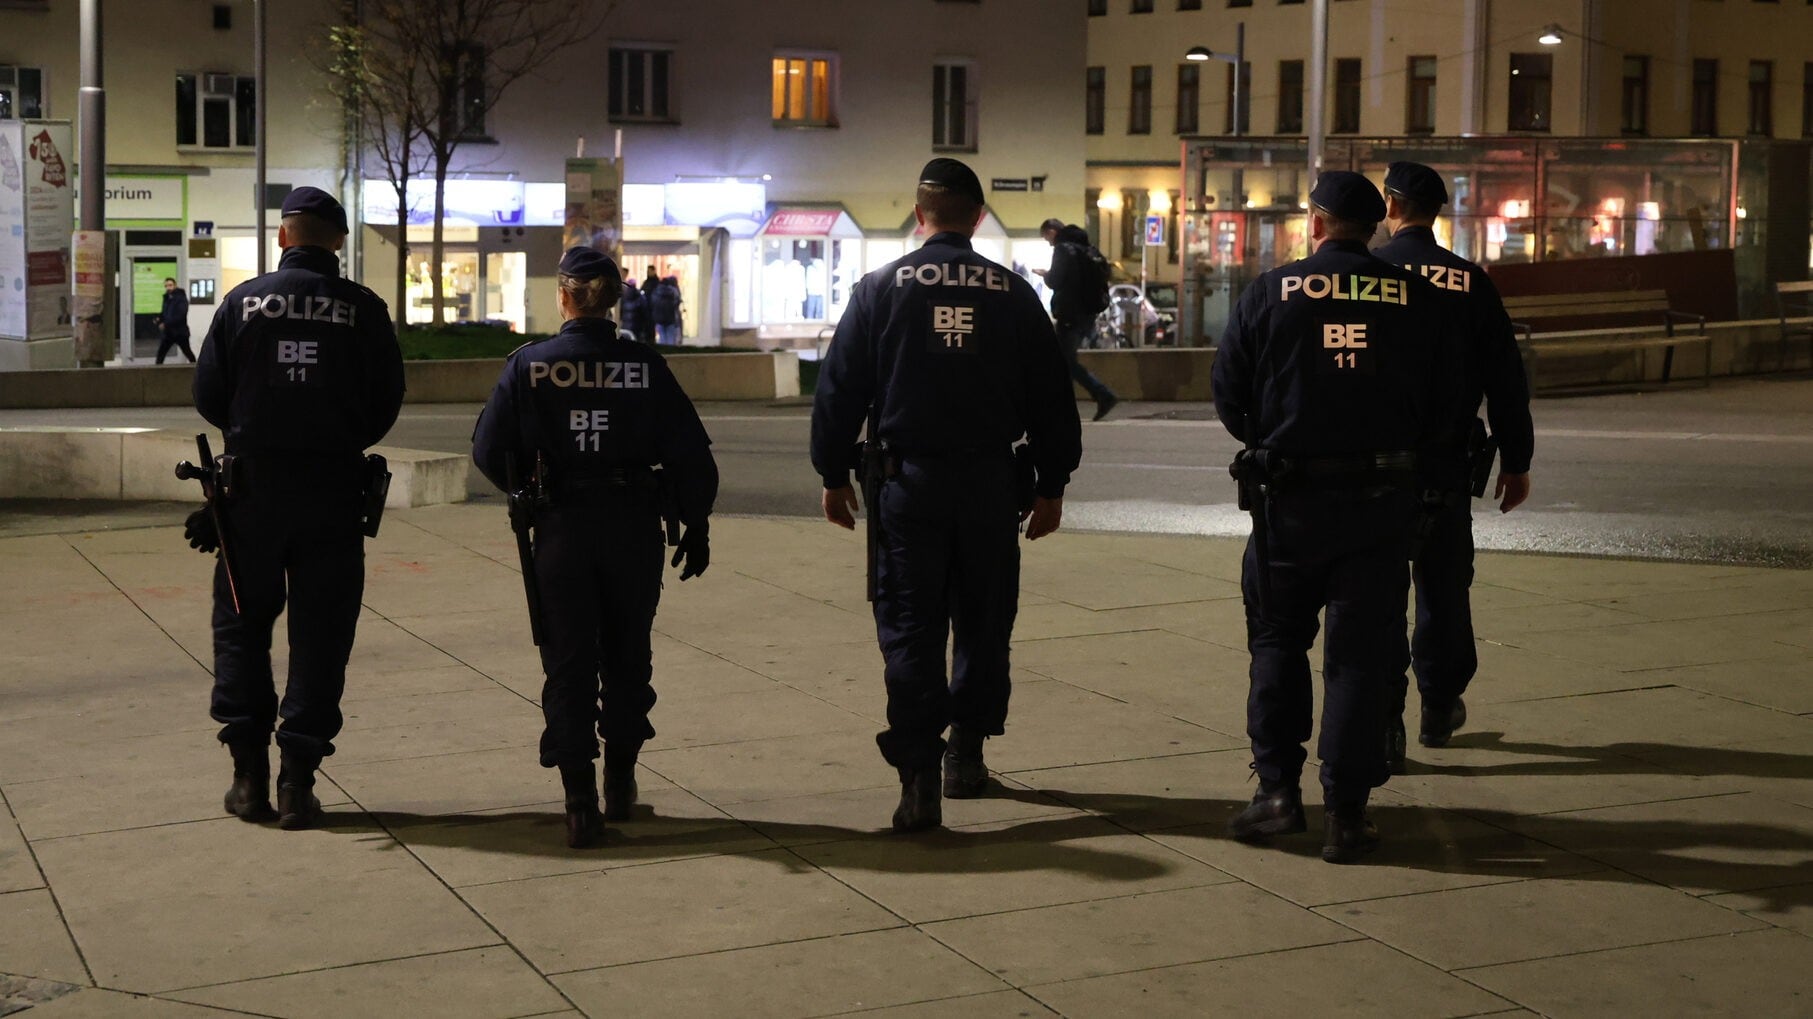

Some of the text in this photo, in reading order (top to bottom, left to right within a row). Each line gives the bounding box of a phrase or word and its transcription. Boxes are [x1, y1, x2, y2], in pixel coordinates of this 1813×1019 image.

[895, 262, 1010, 292] POLIZEI
[1281, 273, 1408, 306] POLIZEI
[242, 294, 357, 328] POLIZEI
[933, 306, 974, 331] BE
[944, 333, 963, 348] 11
[1323, 323, 1368, 349] BE
[278, 341, 318, 364] BE
[1334, 352, 1356, 369] 11
[287, 367, 307, 381] 11
[529, 361, 649, 388] POLIZEI
[570, 410, 609, 432] BE
[576, 432, 602, 451] 11
